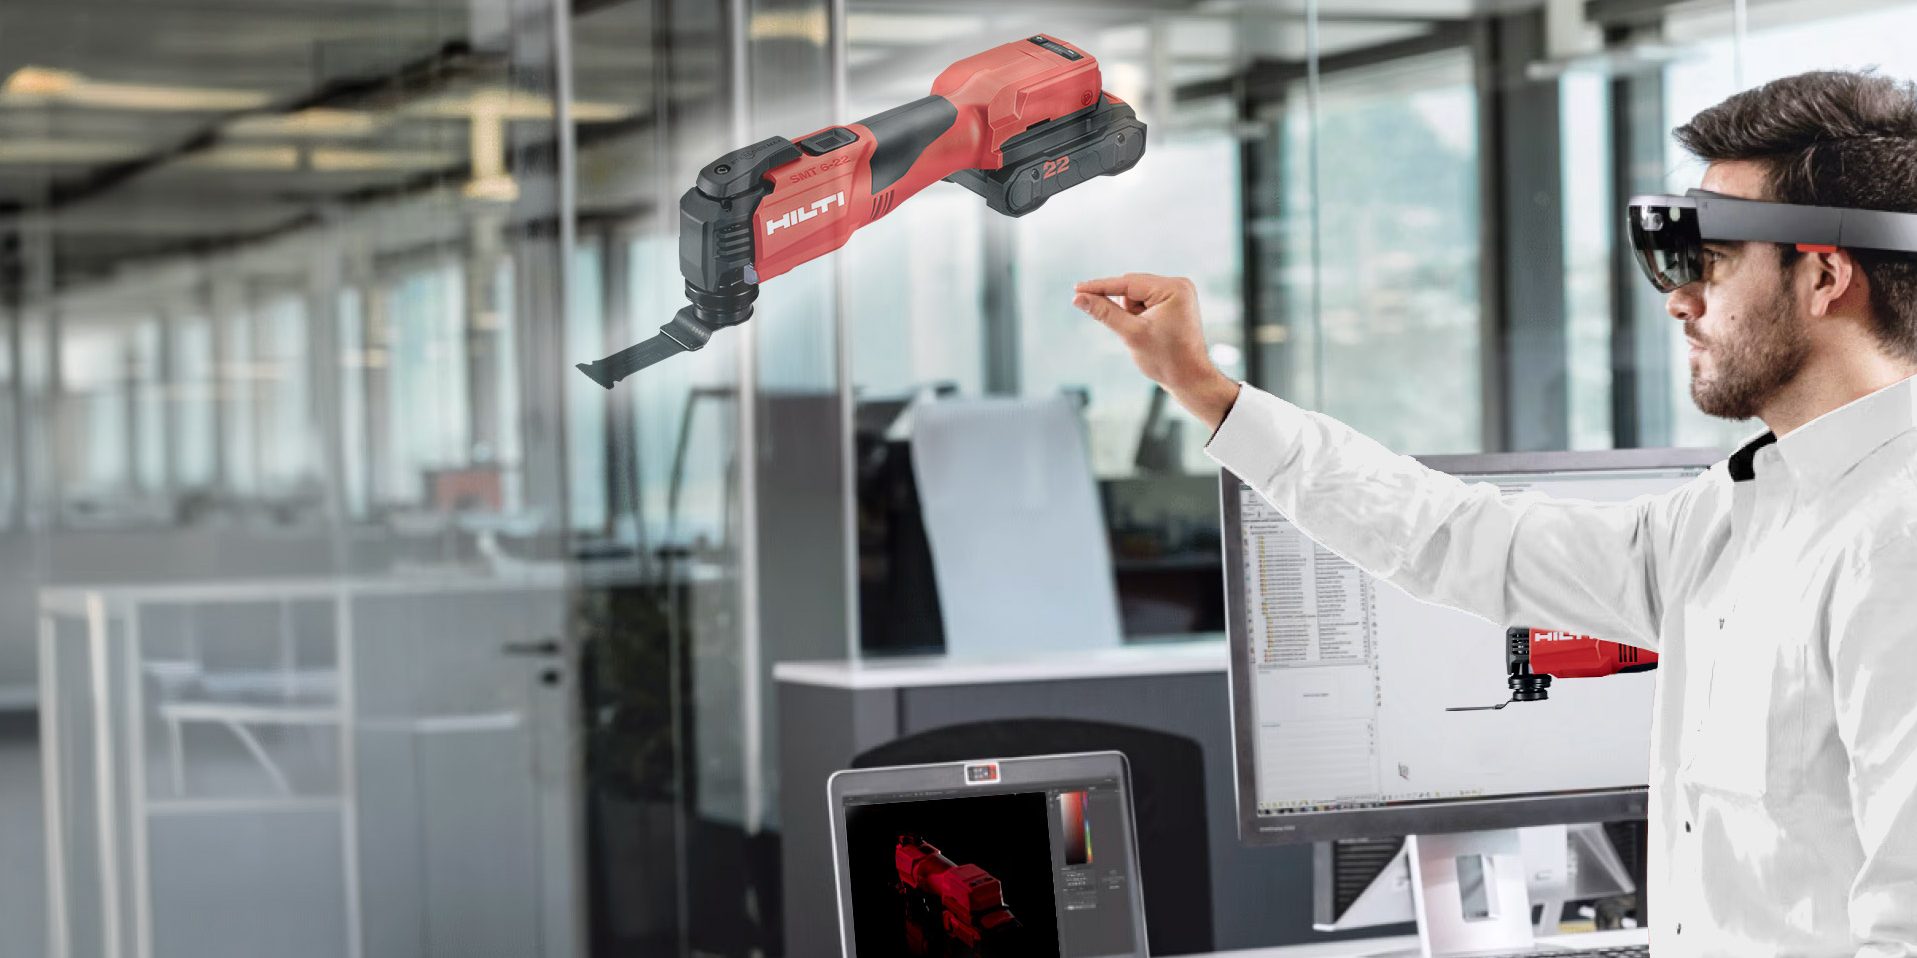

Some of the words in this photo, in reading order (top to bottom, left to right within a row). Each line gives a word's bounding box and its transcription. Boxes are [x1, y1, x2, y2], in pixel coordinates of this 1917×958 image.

[790, 167, 818, 184] SMT
[821, 156, 851, 173] 6-22
[1043, 156, 1070, 180] 22
[766, 191, 845, 236] HILTI
